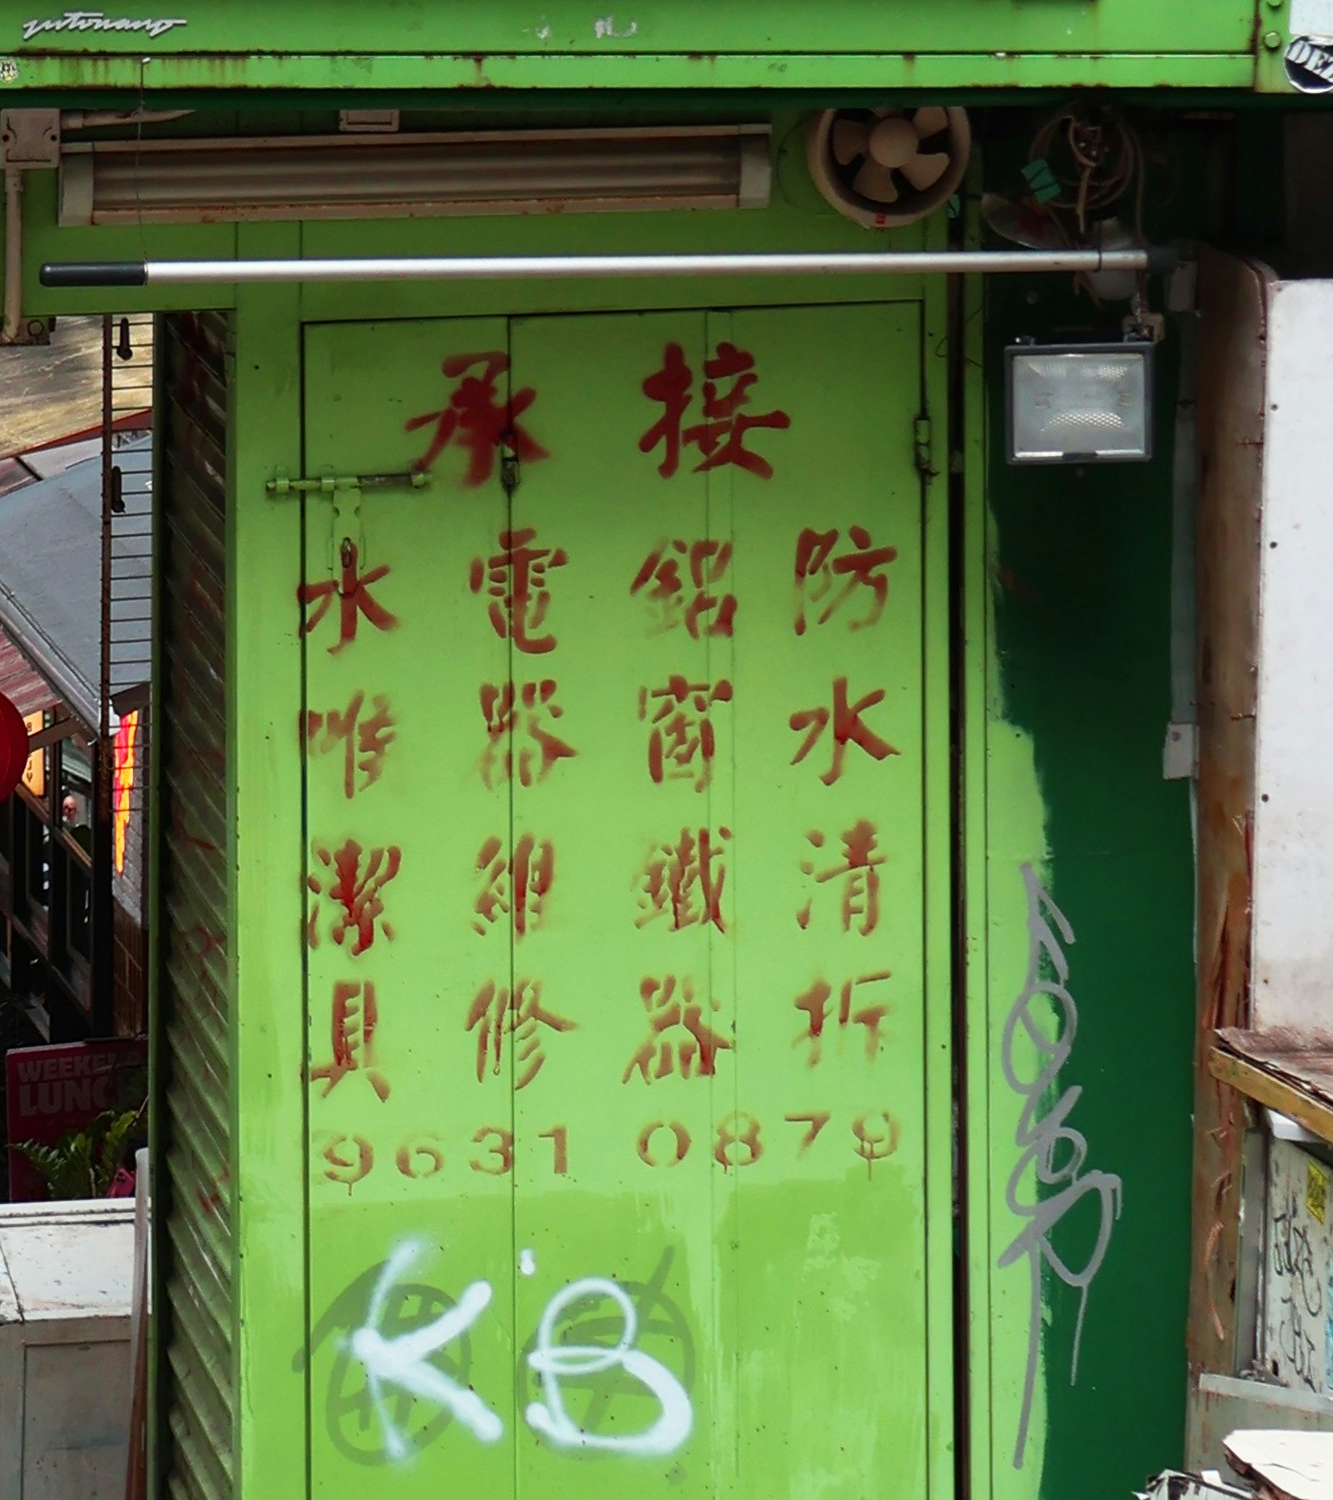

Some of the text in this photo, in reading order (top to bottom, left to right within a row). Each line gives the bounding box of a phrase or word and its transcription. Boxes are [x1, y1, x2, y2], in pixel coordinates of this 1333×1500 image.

[405, 341, 793, 489] 承接
[321, 1123, 572, 1197] 9631
[635, 1109, 901, 1182] 0879
